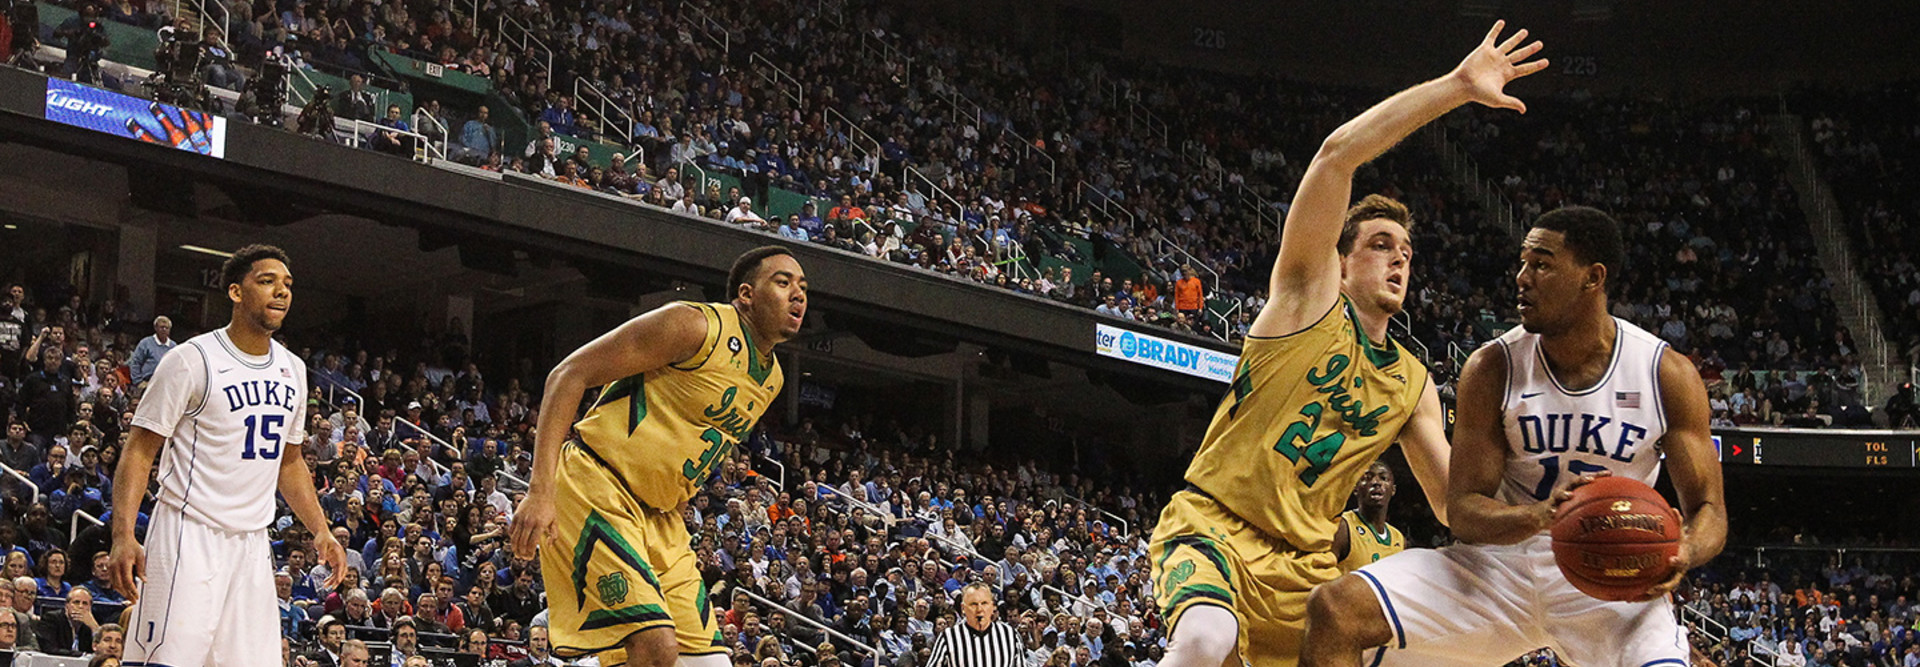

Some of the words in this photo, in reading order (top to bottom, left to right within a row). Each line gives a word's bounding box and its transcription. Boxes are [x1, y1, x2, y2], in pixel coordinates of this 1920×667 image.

[1194, 27, 1226, 49] 226
[47, 93, 113, 117] LIGHT
[560, 140, 575, 153] 230
[1138, 338, 1201, 370] BRADY
[223, 380, 296, 412] DUKE
[1307, 354, 1389, 436] Irish
[241, 414, 284, 460] 15
[1273, 401, 1346, 488] 24
[1518, 413, 1647, 463] DUKE
[1865, 442, 1888, 451] TOL
[1866, 456, 1888, 465] FLS
